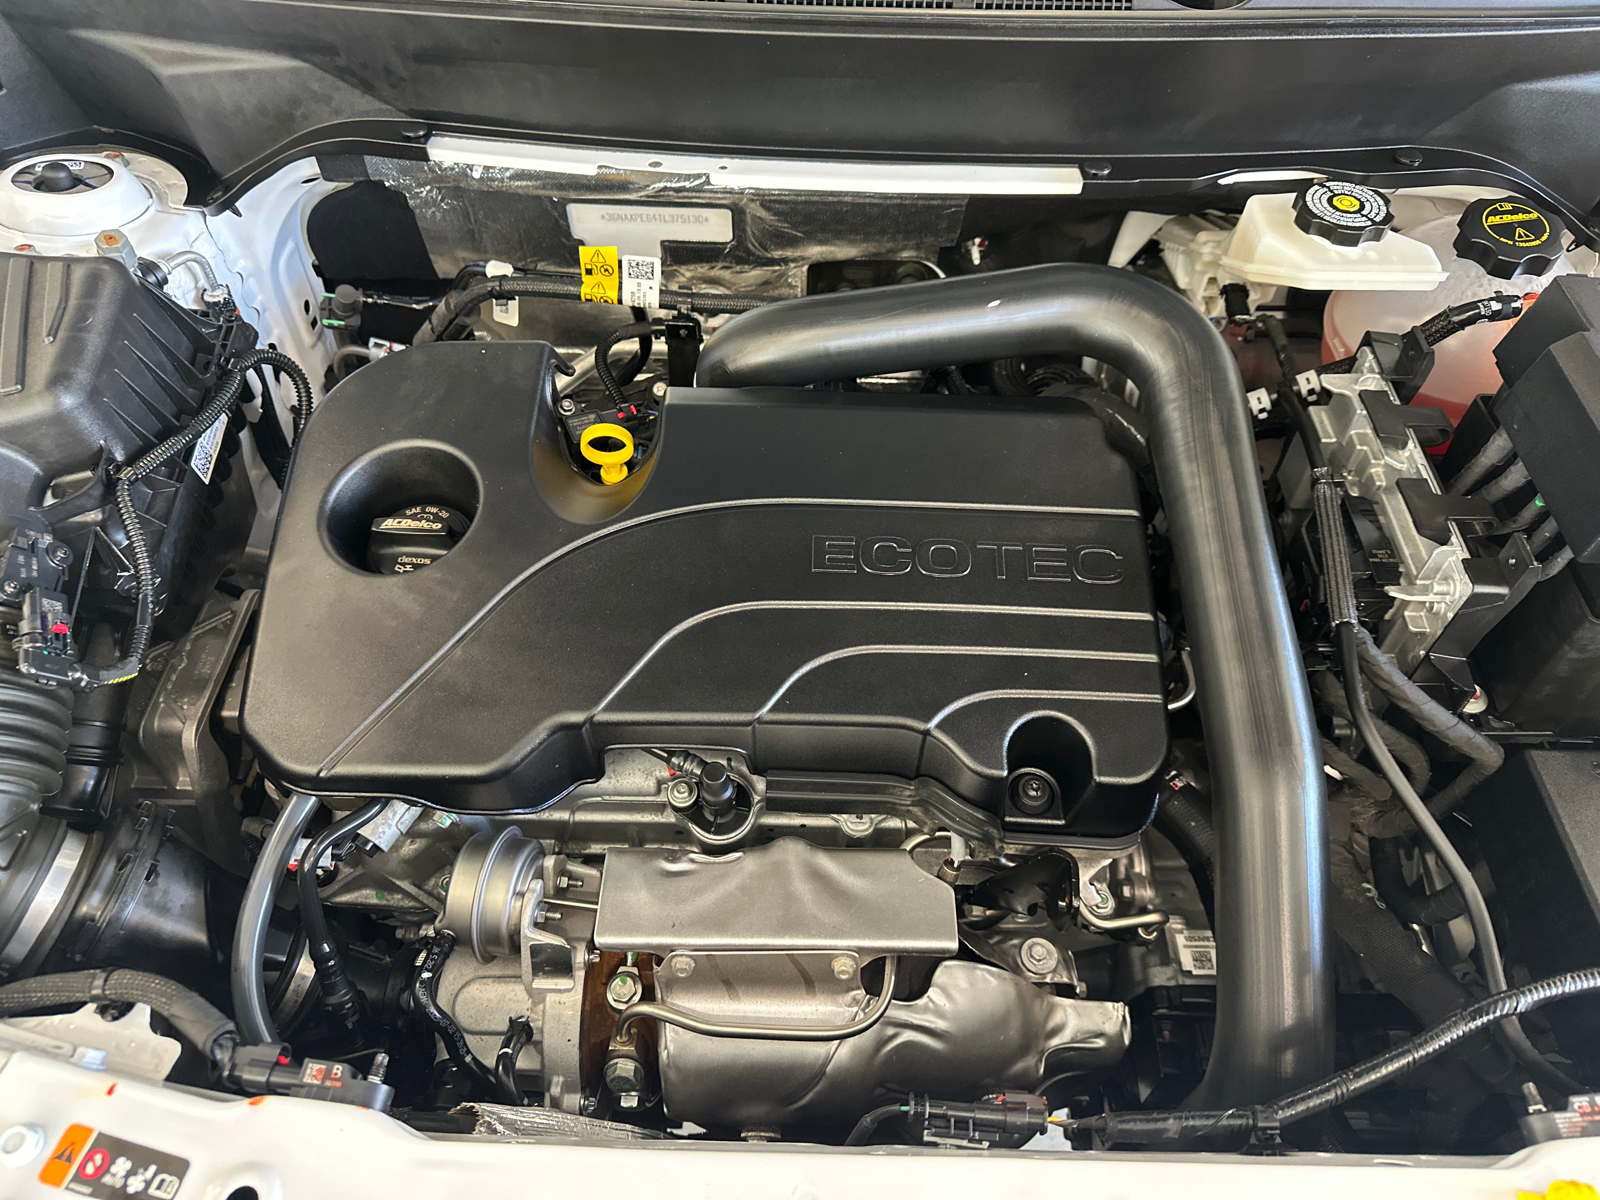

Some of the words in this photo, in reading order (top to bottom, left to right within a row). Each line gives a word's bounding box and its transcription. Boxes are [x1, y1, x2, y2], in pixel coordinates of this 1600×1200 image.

[1486, 212, 1539, 224] ACDelco
[405, 506, 422, 516] SAE
[425, 505, 450, 519] 0W-20
[379, 517, 443, 530] ACDelco
[397, 555, 432, 564] dexos
[811, 534, 1125, 585] ECOTEC
[330, 1064, 343, 1079] B
